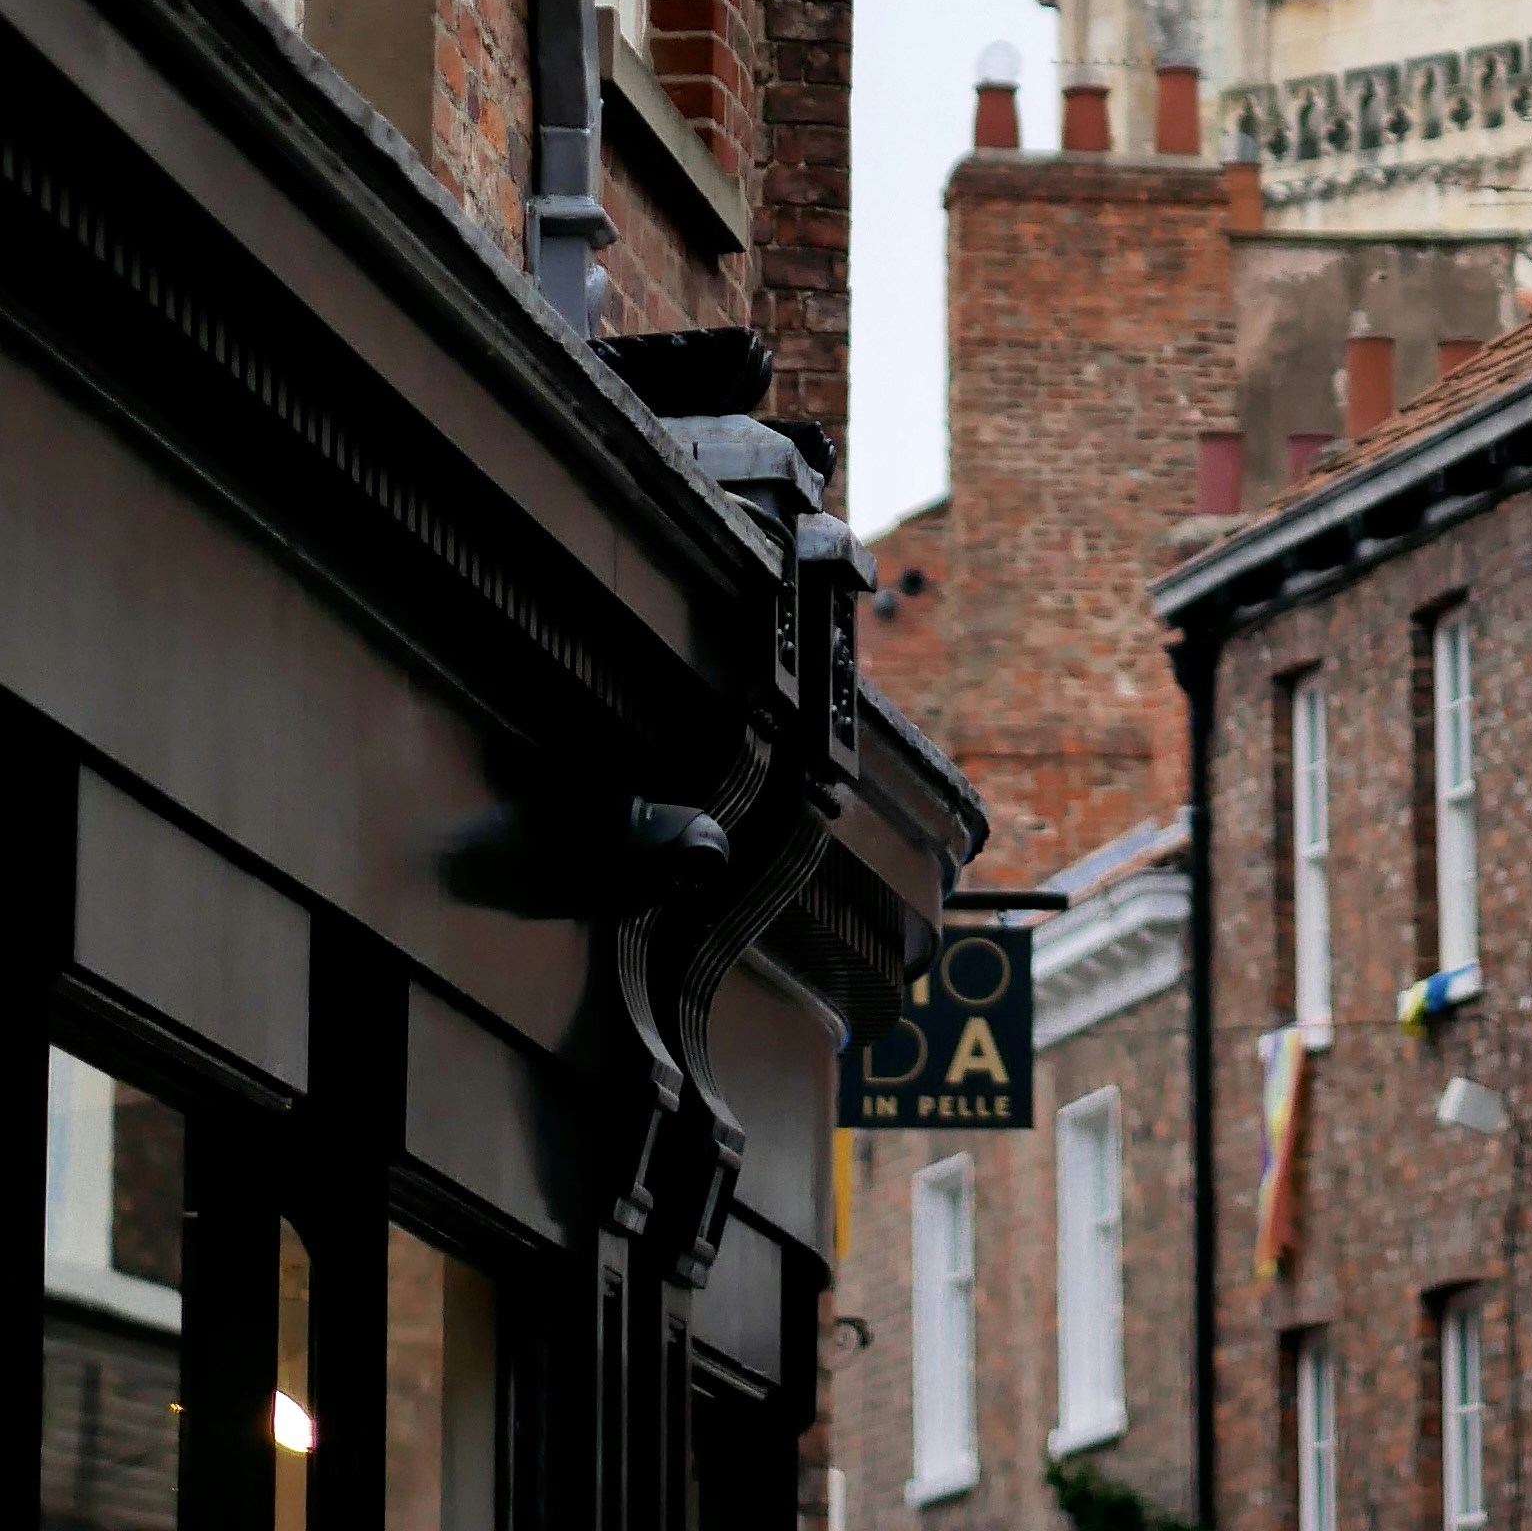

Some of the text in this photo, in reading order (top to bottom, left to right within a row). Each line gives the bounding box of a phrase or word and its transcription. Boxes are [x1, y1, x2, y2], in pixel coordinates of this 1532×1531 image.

[911, 938, 1011, 1006] O
[862, 1016, 1010, 1085] DA
[862, 1095, 1012, 1118] IN PELLE
